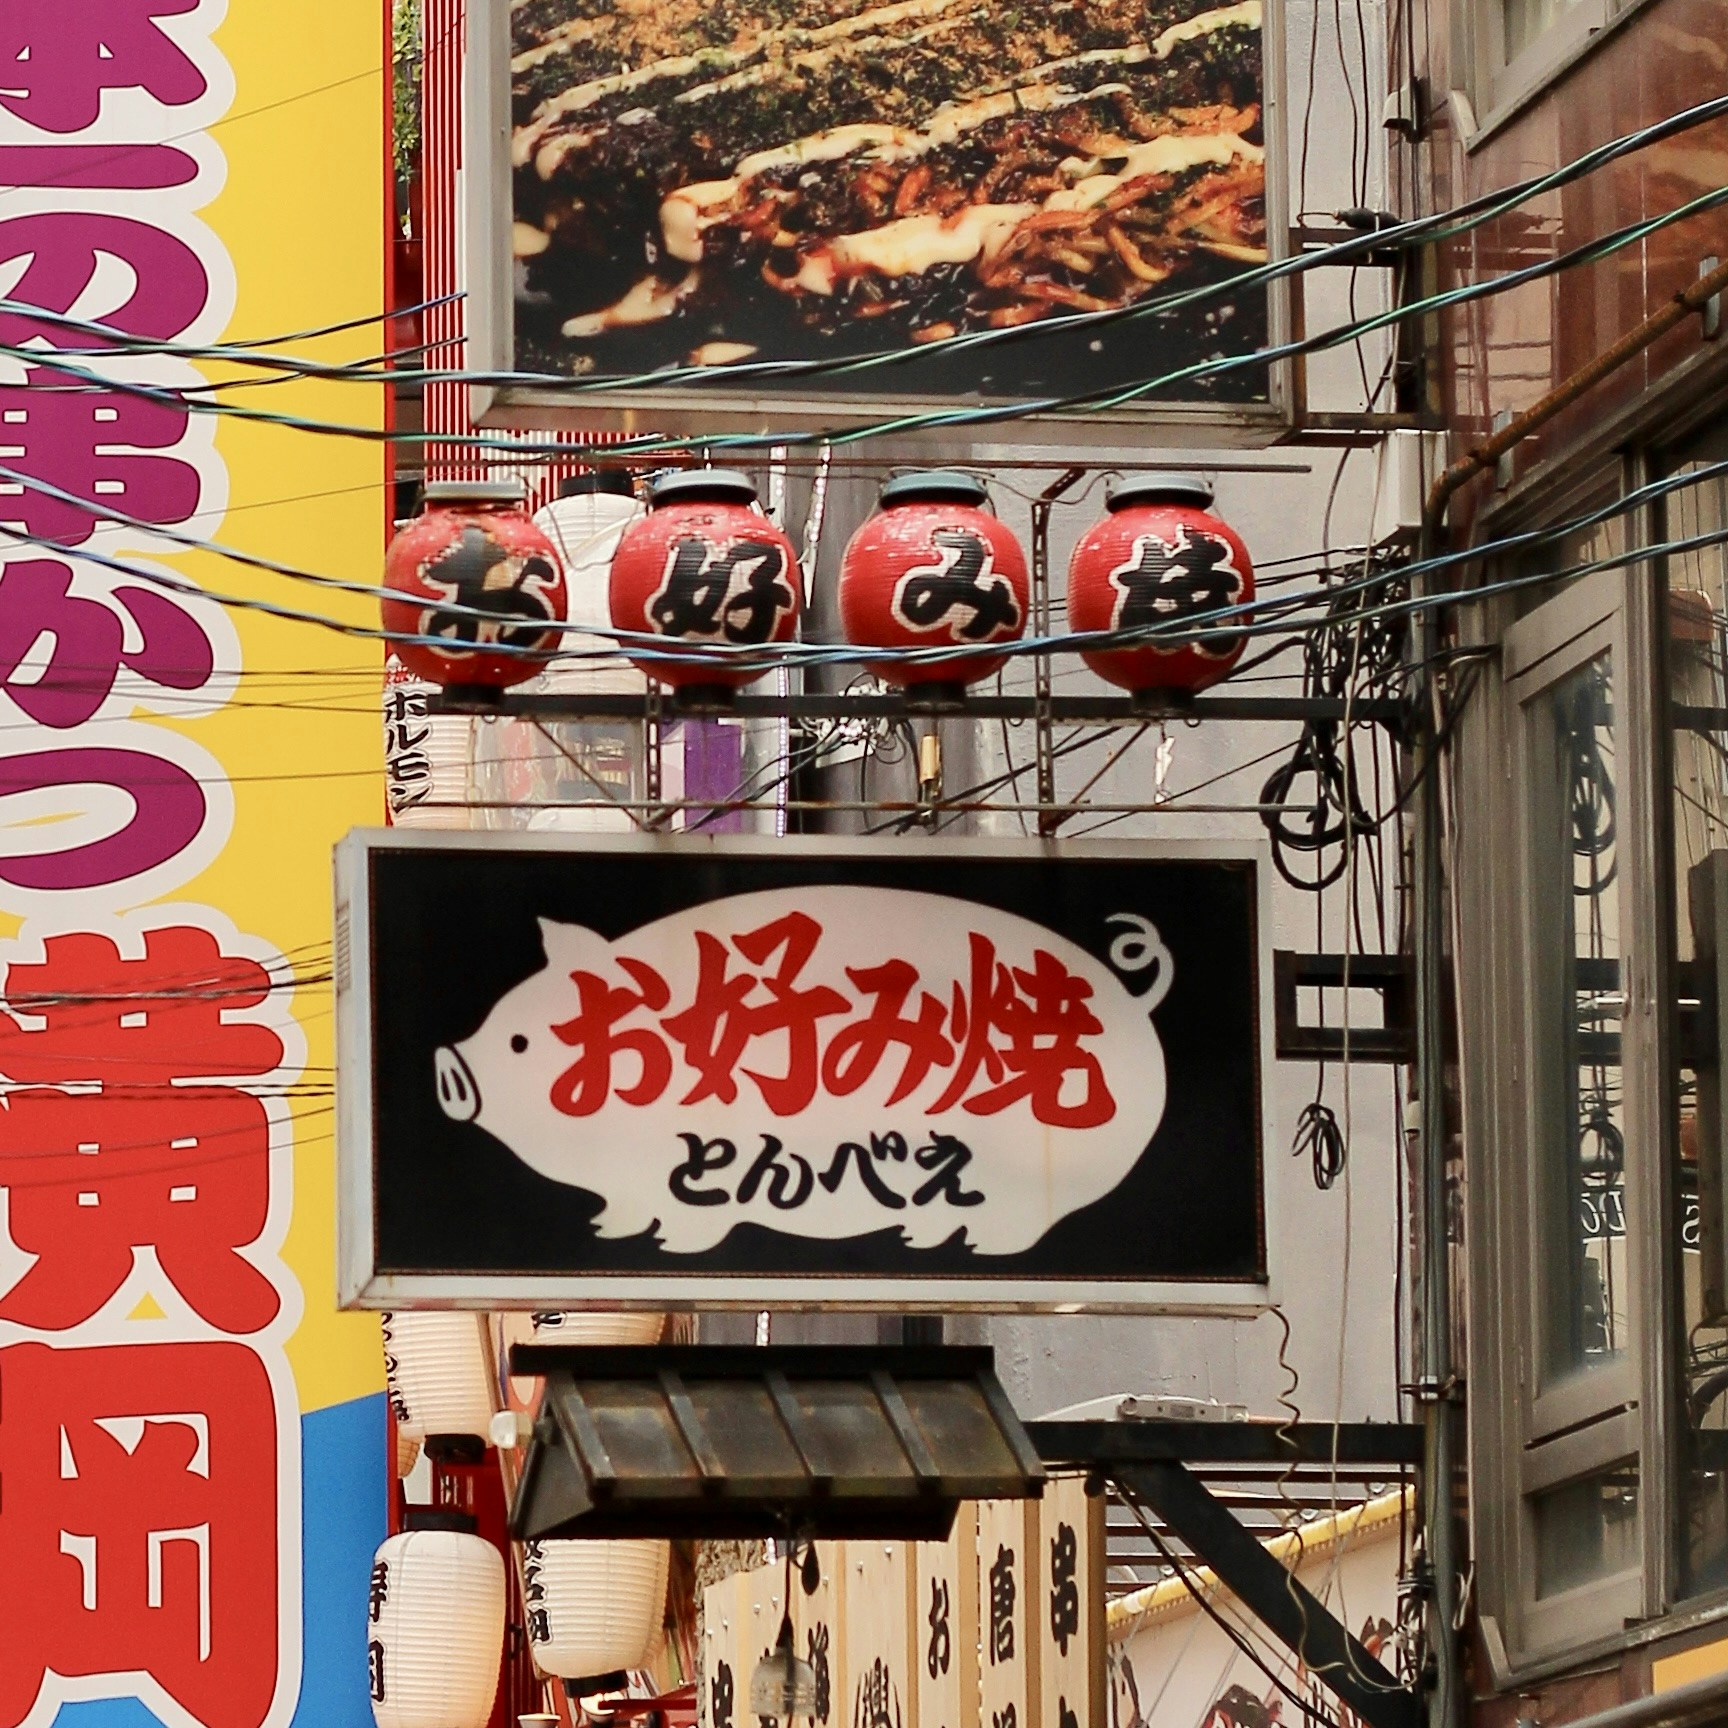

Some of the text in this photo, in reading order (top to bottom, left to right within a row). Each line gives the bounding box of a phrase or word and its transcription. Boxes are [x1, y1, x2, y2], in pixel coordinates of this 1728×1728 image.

[385, 691, 431, 814] ホルモン
[548, 910, 1117, 1130] お好み焼
[667, 1129, 985, 1208] とんべえ
